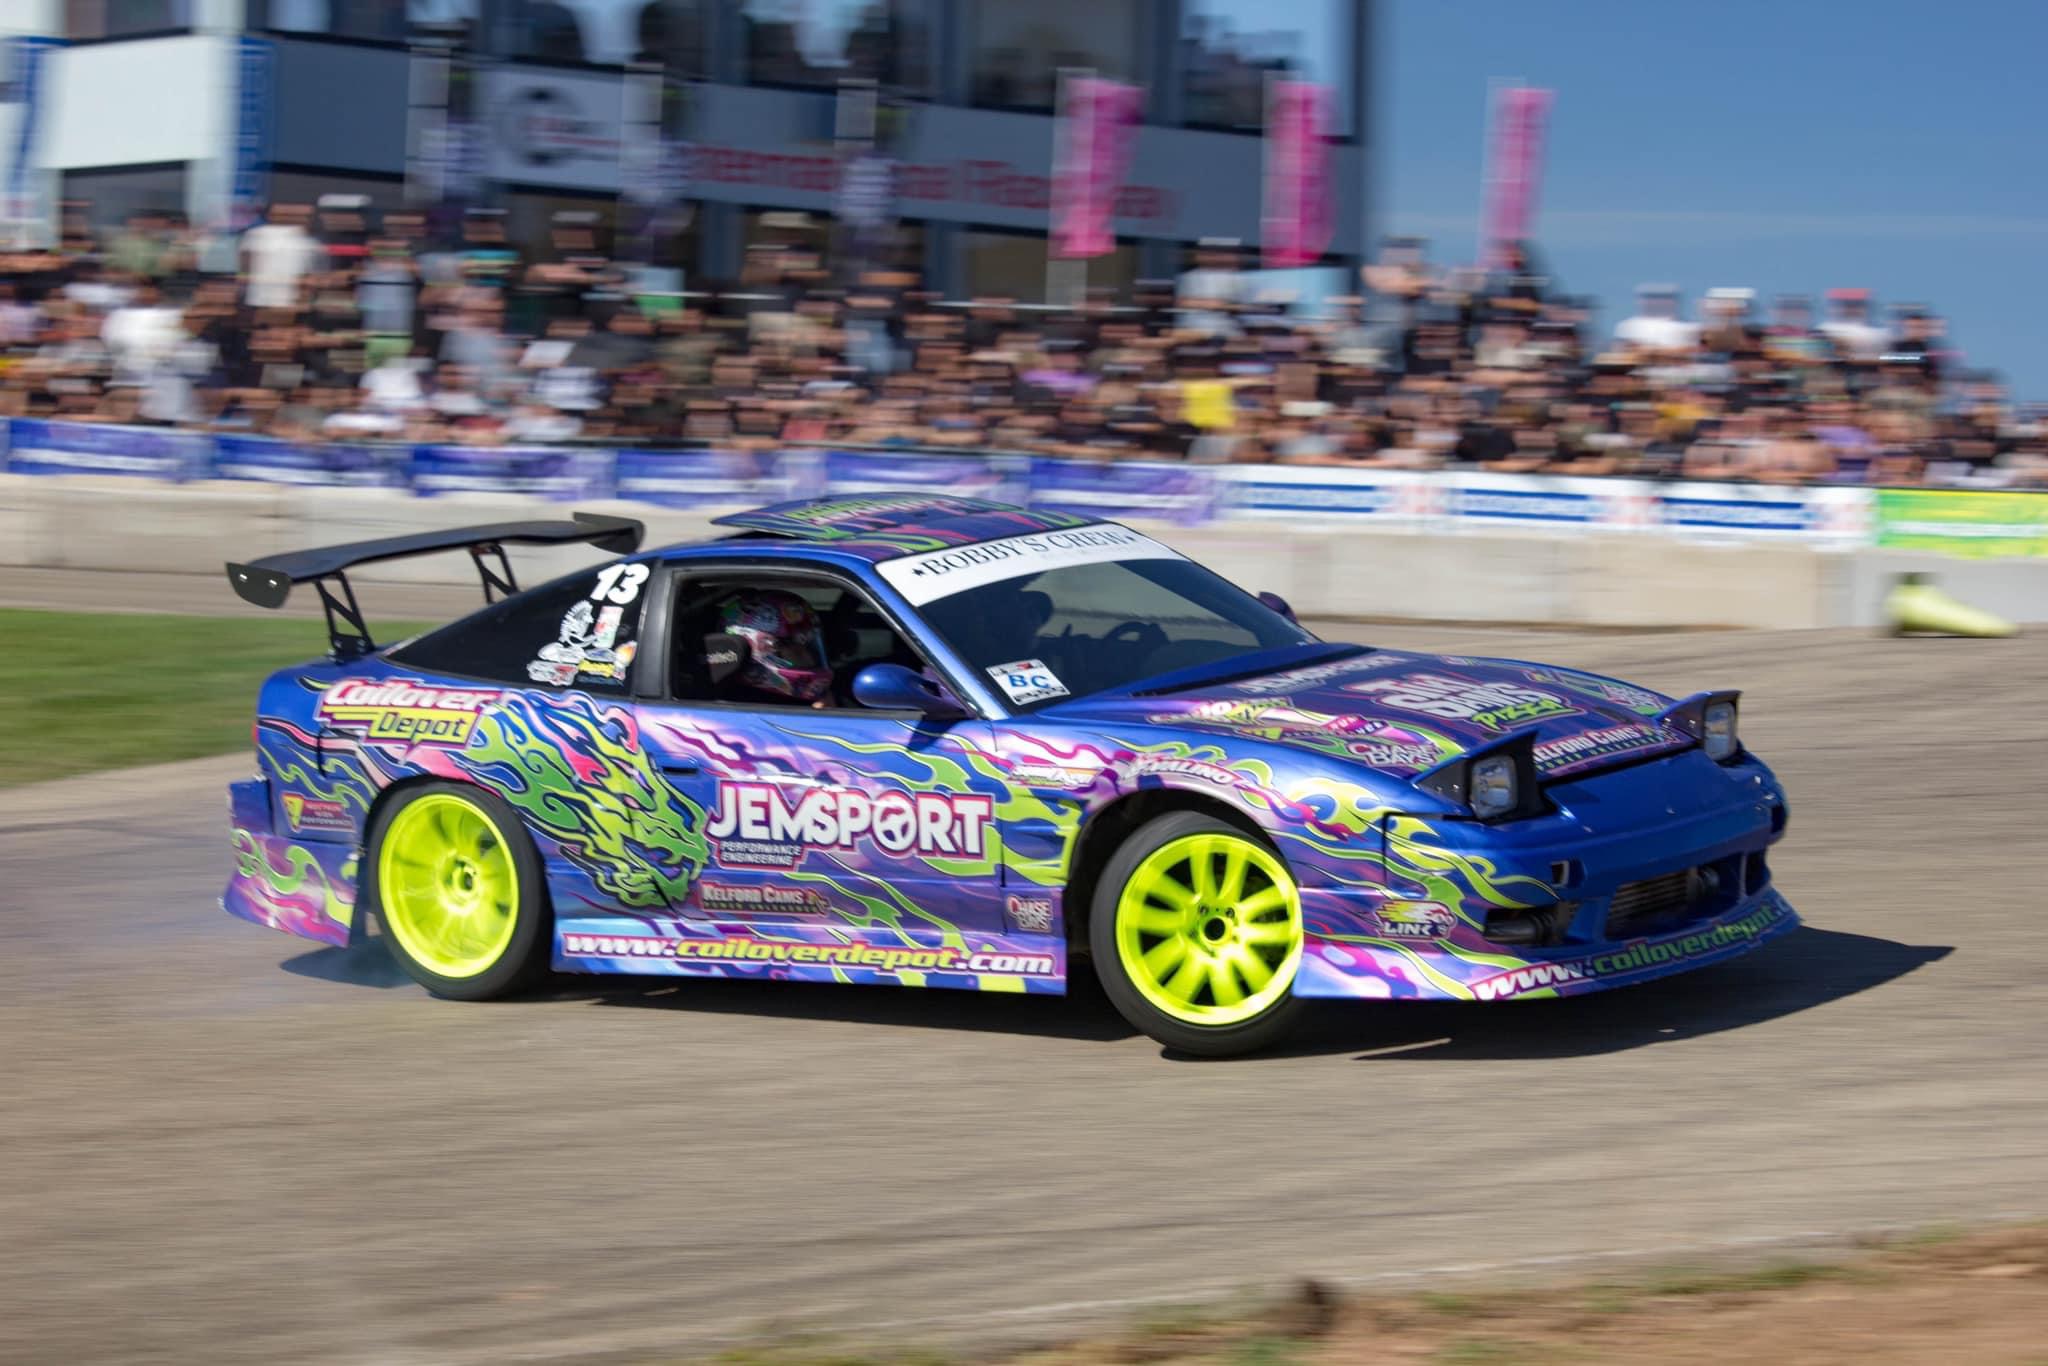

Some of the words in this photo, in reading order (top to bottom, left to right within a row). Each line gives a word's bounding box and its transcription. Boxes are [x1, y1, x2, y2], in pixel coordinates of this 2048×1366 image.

[921, 534, 1043, 575] BOBBY'S
[1047, 530, 1128, 550] CREW
[590, 563, 650, 604] 13
[325, 679, 496, 711] Coilover
[378, 712, 467, 742] Depot
[707, 785, 990, 854] JEMSPORT
[721, 840, 801, 856] PERFORMANCE
[721, 851, 794, 867] ENGINEERING
[566, 936, 1054, 973] www.coiloverdepot.com
